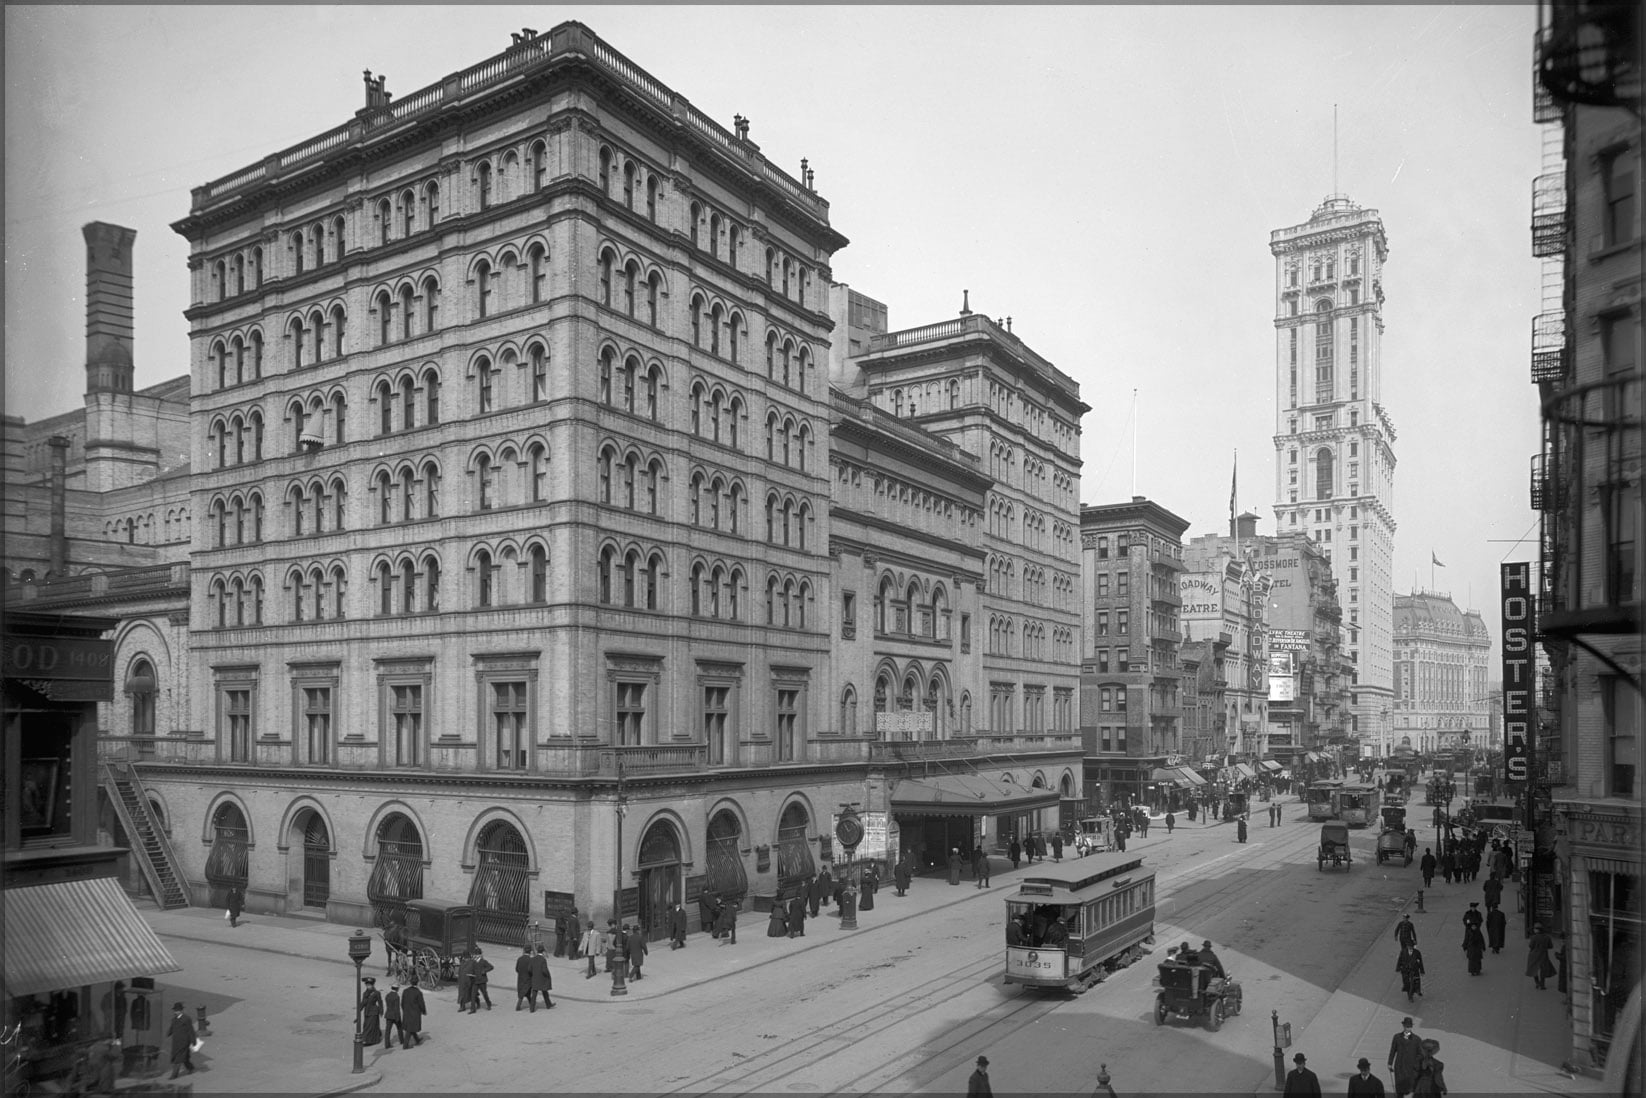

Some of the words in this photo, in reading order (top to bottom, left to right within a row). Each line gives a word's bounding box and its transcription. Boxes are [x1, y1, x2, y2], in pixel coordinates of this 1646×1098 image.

[1254, 559, 1299, 570] OSSMORE
[1180, 580, 1219, 596] OADWAY
[1273, 579, 1292, 588] TEL
[1182, 603, 1219, 614] EATRE.
[1253, 583, 1263, 687] BROADWAY
[1505, 566, 1528, 781] HOSTER'S
